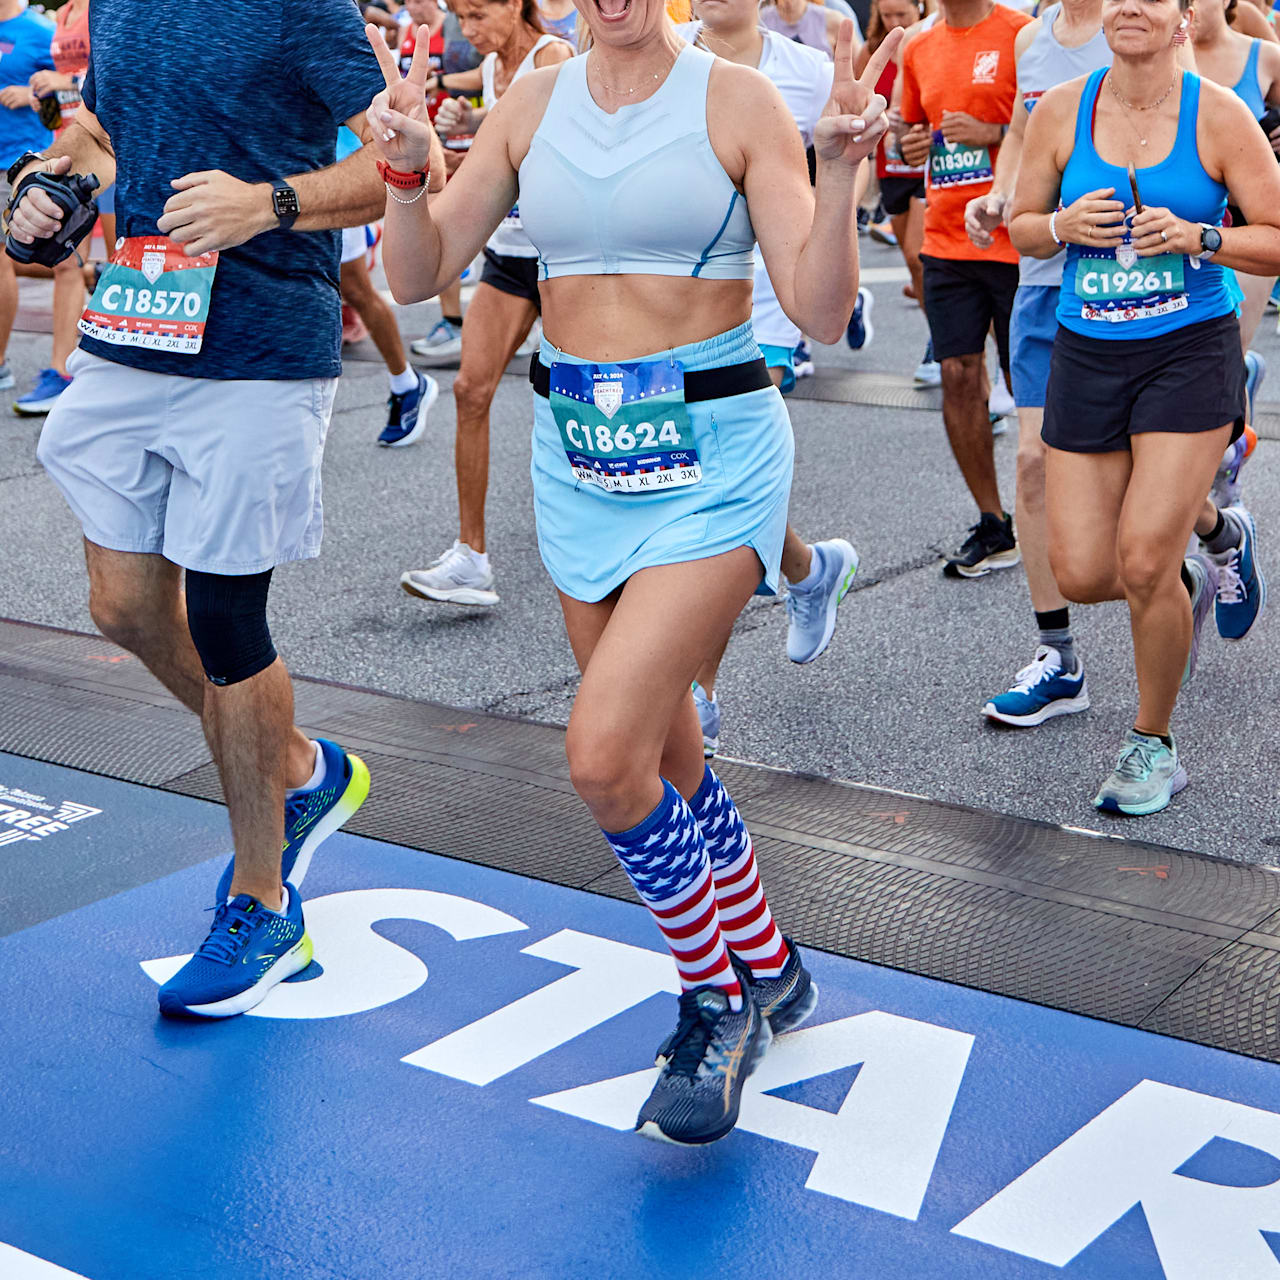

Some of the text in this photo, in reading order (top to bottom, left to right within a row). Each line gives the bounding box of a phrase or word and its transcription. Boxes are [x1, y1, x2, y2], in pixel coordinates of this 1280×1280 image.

[932, 149, 984, 172] C18307
[1082, 271, 1173, 295] C19261
[101, 284, 202, 318] C18570
[106, 332, 116, 341] XS
[120, 333, 126, 342] S
[130, 334, 138, 342] M
[142, 336, 148, 344] L
[152, 337, 161, 346] XL
[166, 339, 180, 348] 2XL
[185, 341, 197, 350] 3XL
[566, 419, 681, 453] C18624
[670, 452, 690, 461] COX
[627, 479, 632, 488] L
[639, 477, 650, 486] XL
[656, 474, 675, 484] 2XL
[681, 470, 699, 480] 3XL
